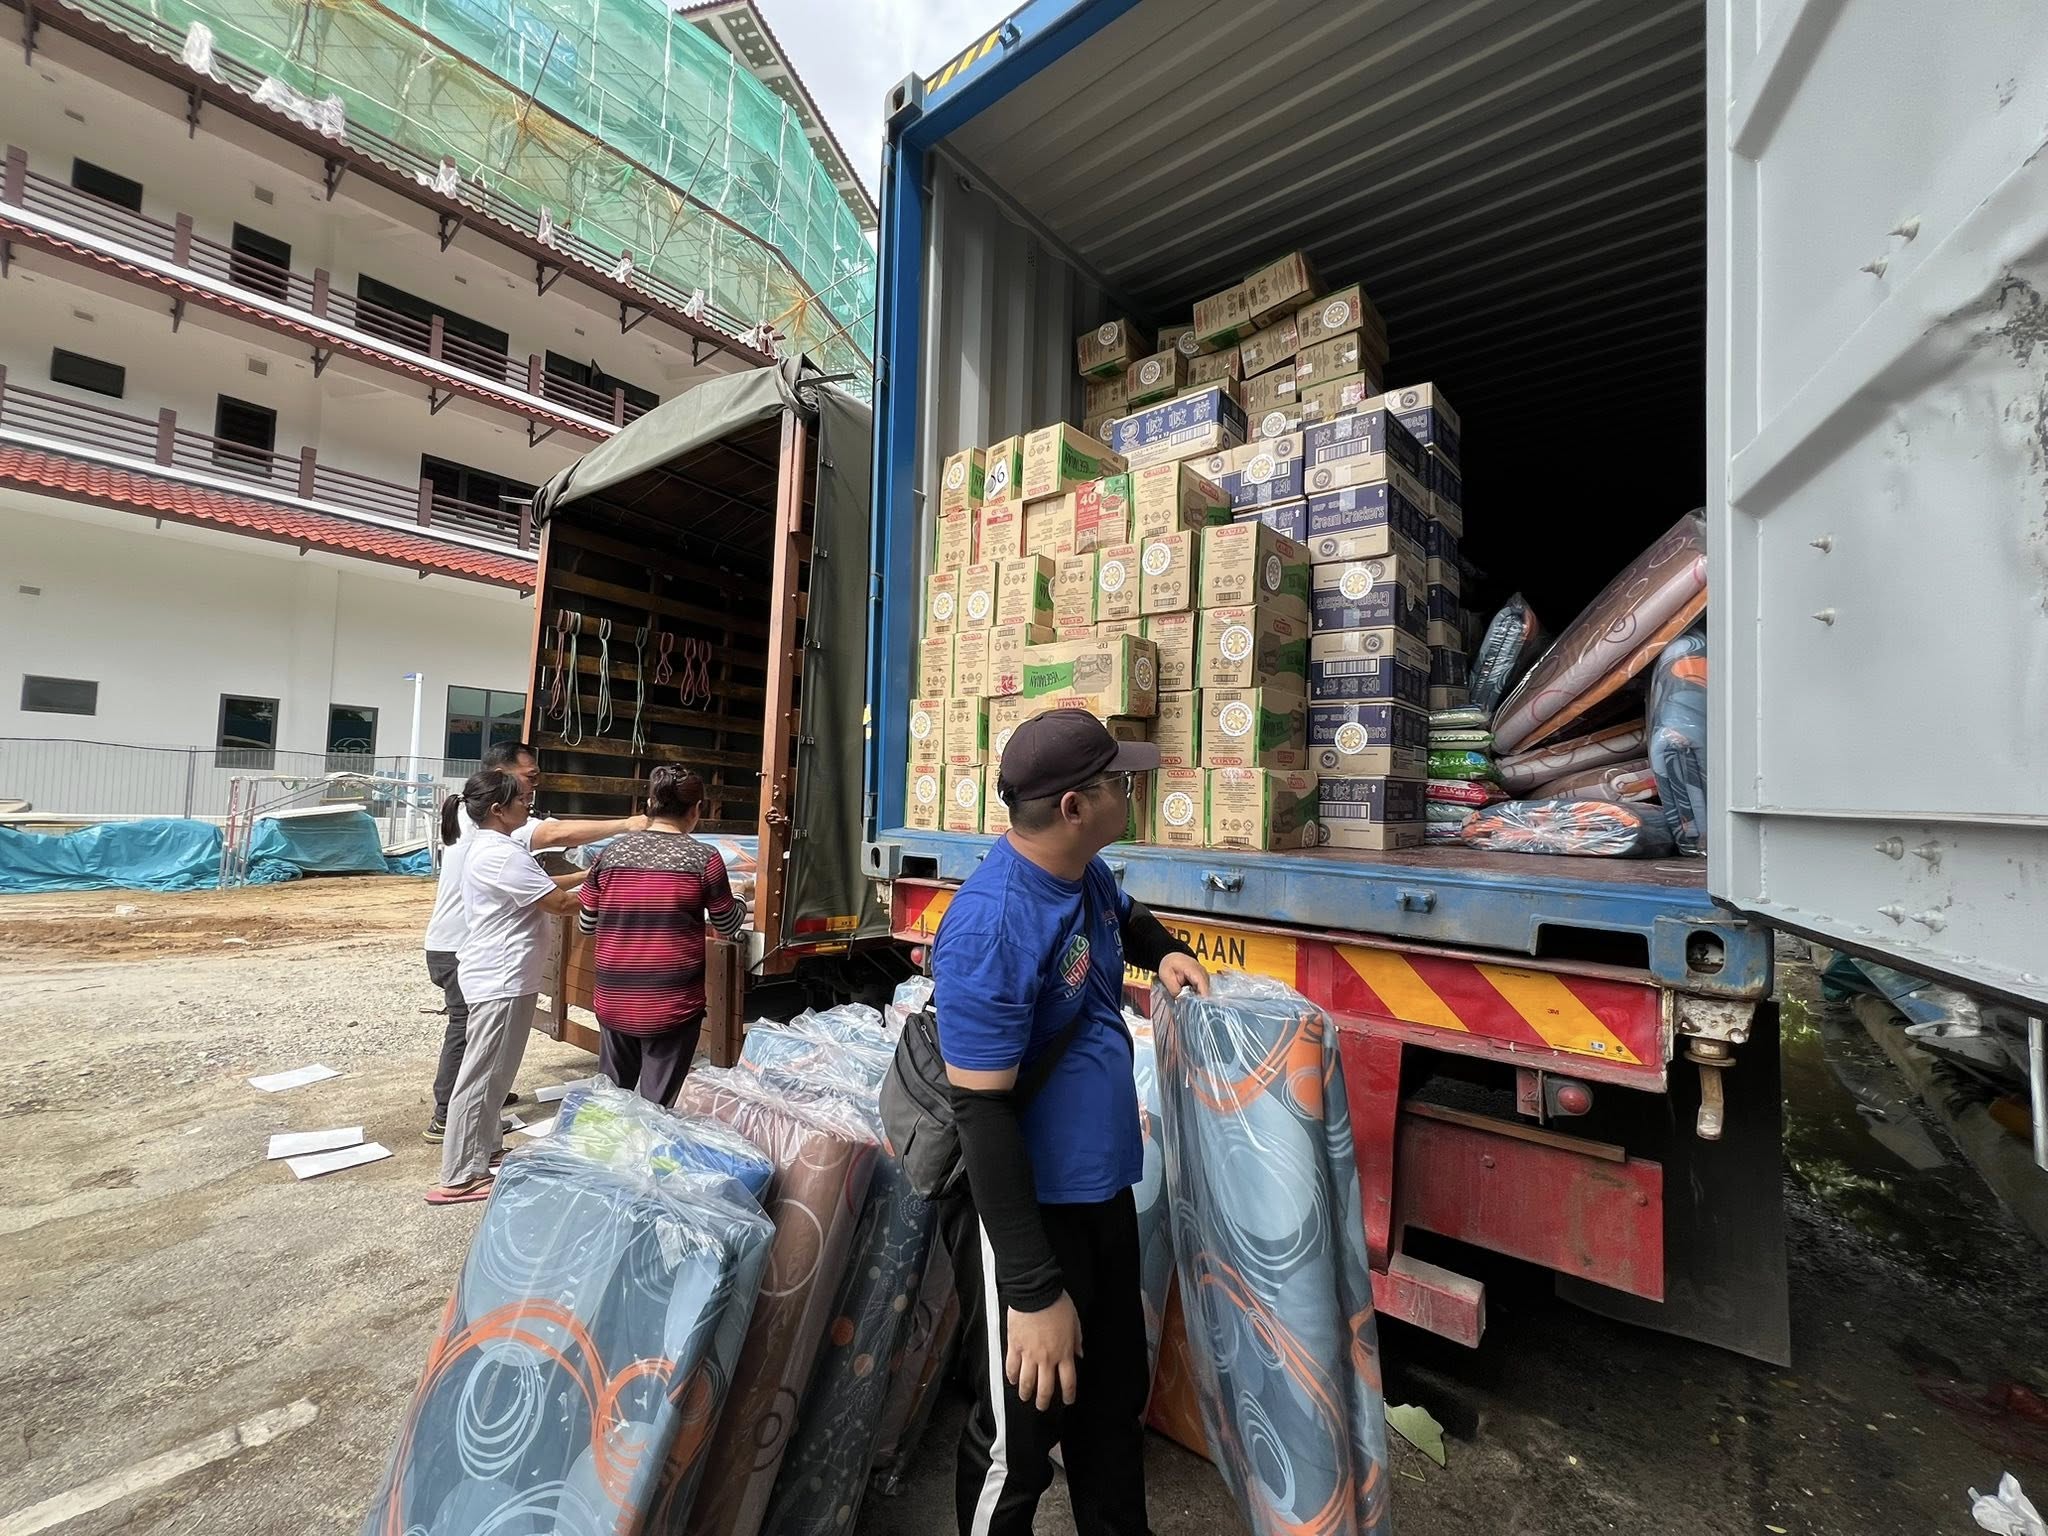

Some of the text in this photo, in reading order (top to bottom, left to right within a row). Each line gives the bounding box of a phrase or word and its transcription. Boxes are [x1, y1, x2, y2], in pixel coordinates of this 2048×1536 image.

[1080, 493, 1097, 505] 40
[1312, 514, 1341, 530] Cream
[1342, 505, 1385, 525] Crackers
[1064, 937, 1087, 968] TAG
